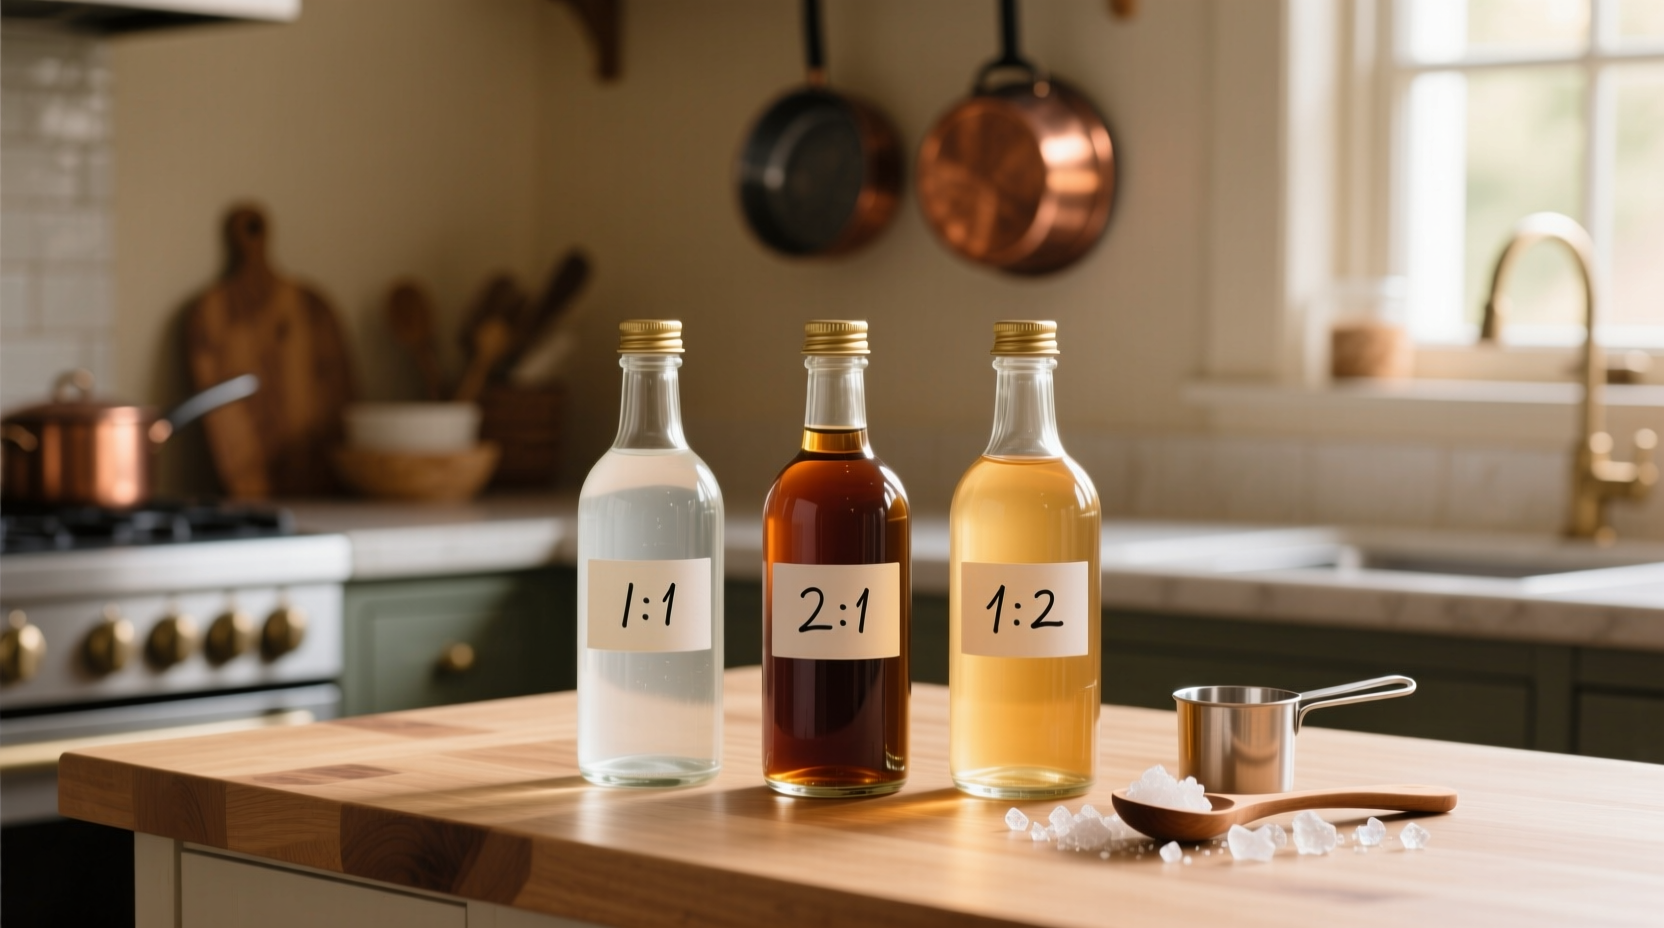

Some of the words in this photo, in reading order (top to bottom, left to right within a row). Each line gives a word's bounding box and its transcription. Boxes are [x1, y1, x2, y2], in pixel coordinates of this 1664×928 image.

[621, 582, 676, 629] 1:1
[798, 586, 870, 634] 2:1
[986, 584, 1064, 634] 1:2
